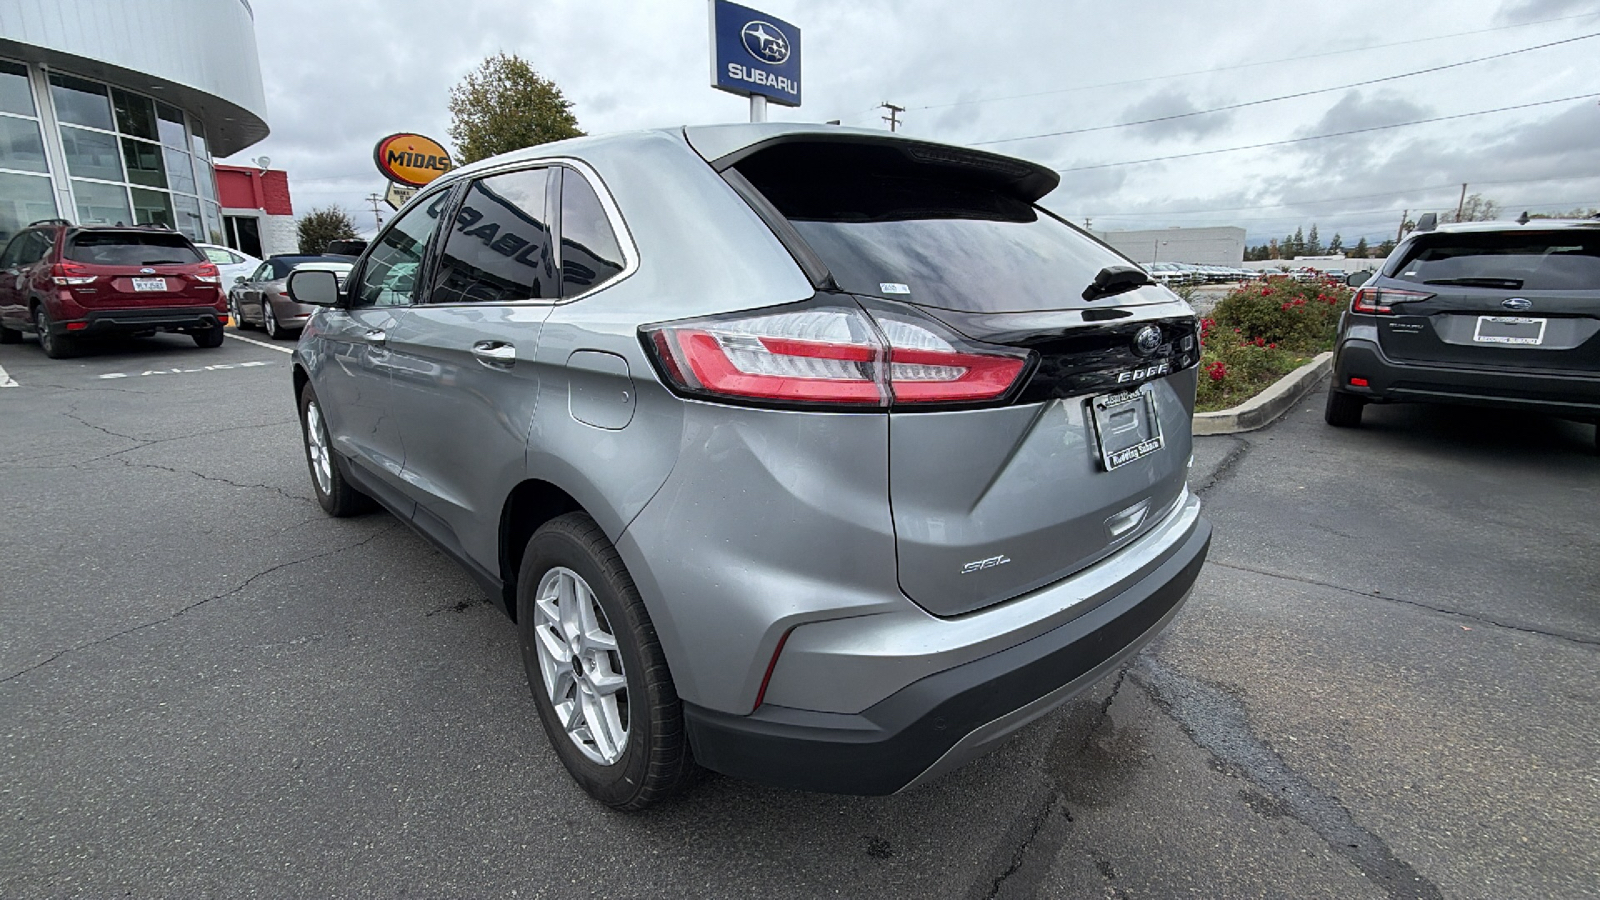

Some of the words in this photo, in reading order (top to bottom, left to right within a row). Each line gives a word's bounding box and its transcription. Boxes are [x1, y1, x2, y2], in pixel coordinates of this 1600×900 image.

[728, 63, 797, 94] SUBARU
[388, 150, 449, 170] MIDAS
[1117, 363, 1168, 383] EDGE
[961, 554, 1011, 574] SEL
